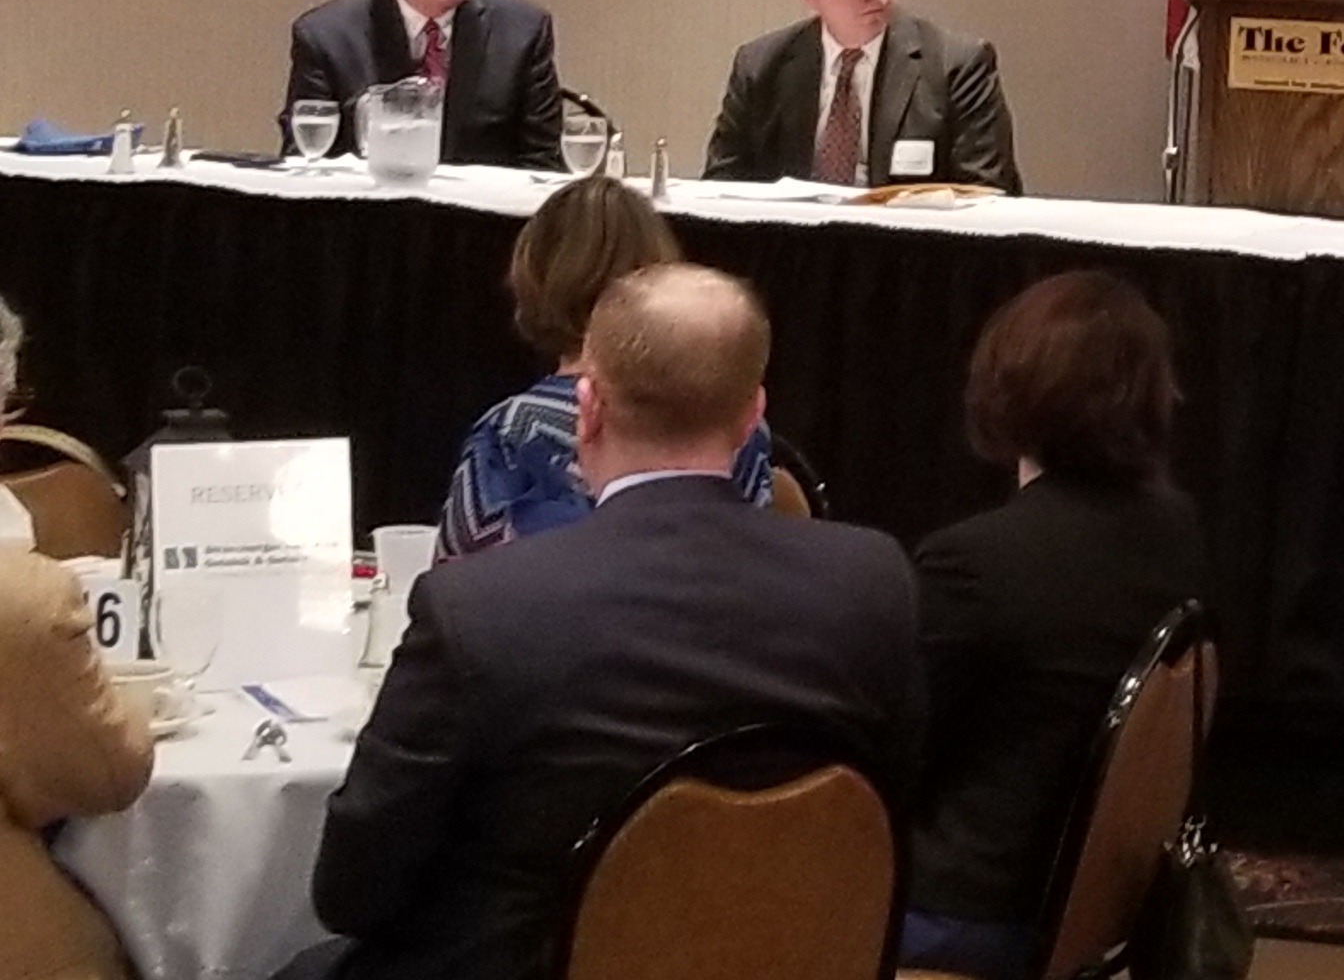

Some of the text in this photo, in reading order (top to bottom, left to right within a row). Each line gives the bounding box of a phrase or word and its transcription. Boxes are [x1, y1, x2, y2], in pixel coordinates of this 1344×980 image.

[1238, 26, 1305, 53] The
[190, 483, 303, 504] RESERV
[83, 591, 121, 649] 6
